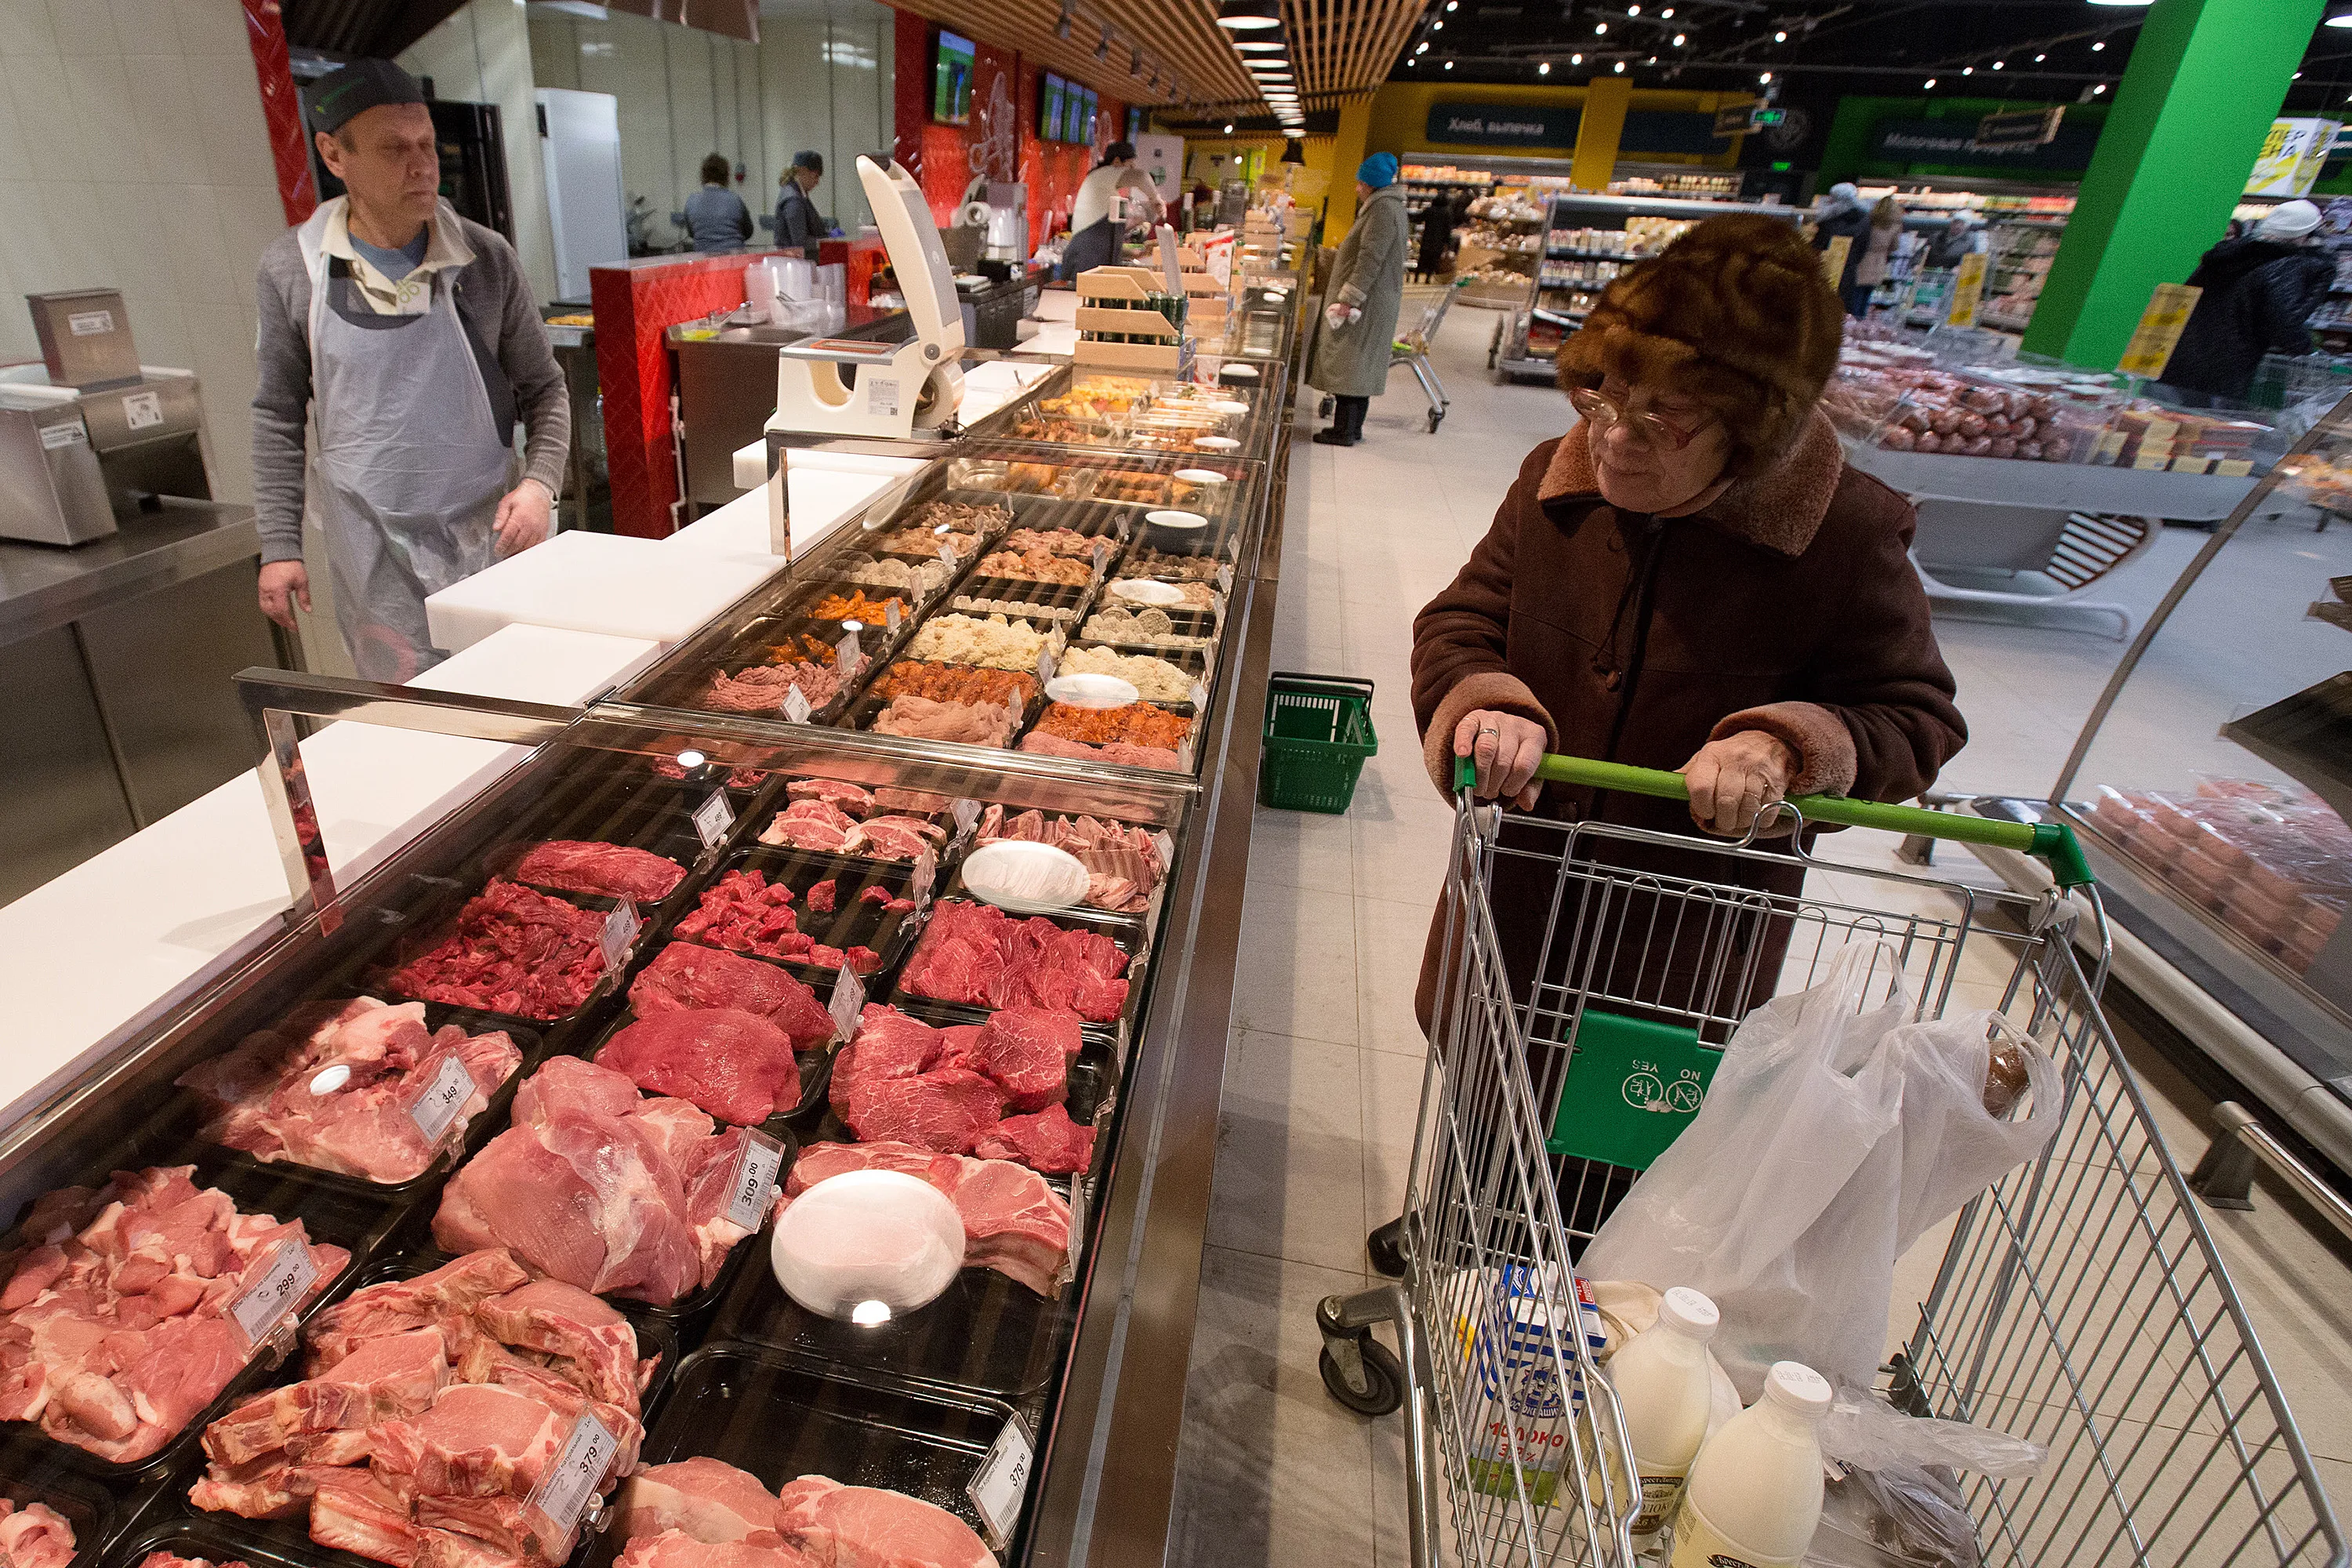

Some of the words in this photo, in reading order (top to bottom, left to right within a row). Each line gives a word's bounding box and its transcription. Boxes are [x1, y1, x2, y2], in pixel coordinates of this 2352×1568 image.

[1632, 1059, 1659, 1073] YES
[1680, 1069, 1701, 1081] NO
[442, 1085, 457, 1105] 349
[292, 1263, 300, 1272] 00
[276, 1272, 295, 1297] 299
[591, 1433, 600, 1445] 00
[579, 1446, 597, 1474] 379
[1009, 1462, 1025, 1486] 379
